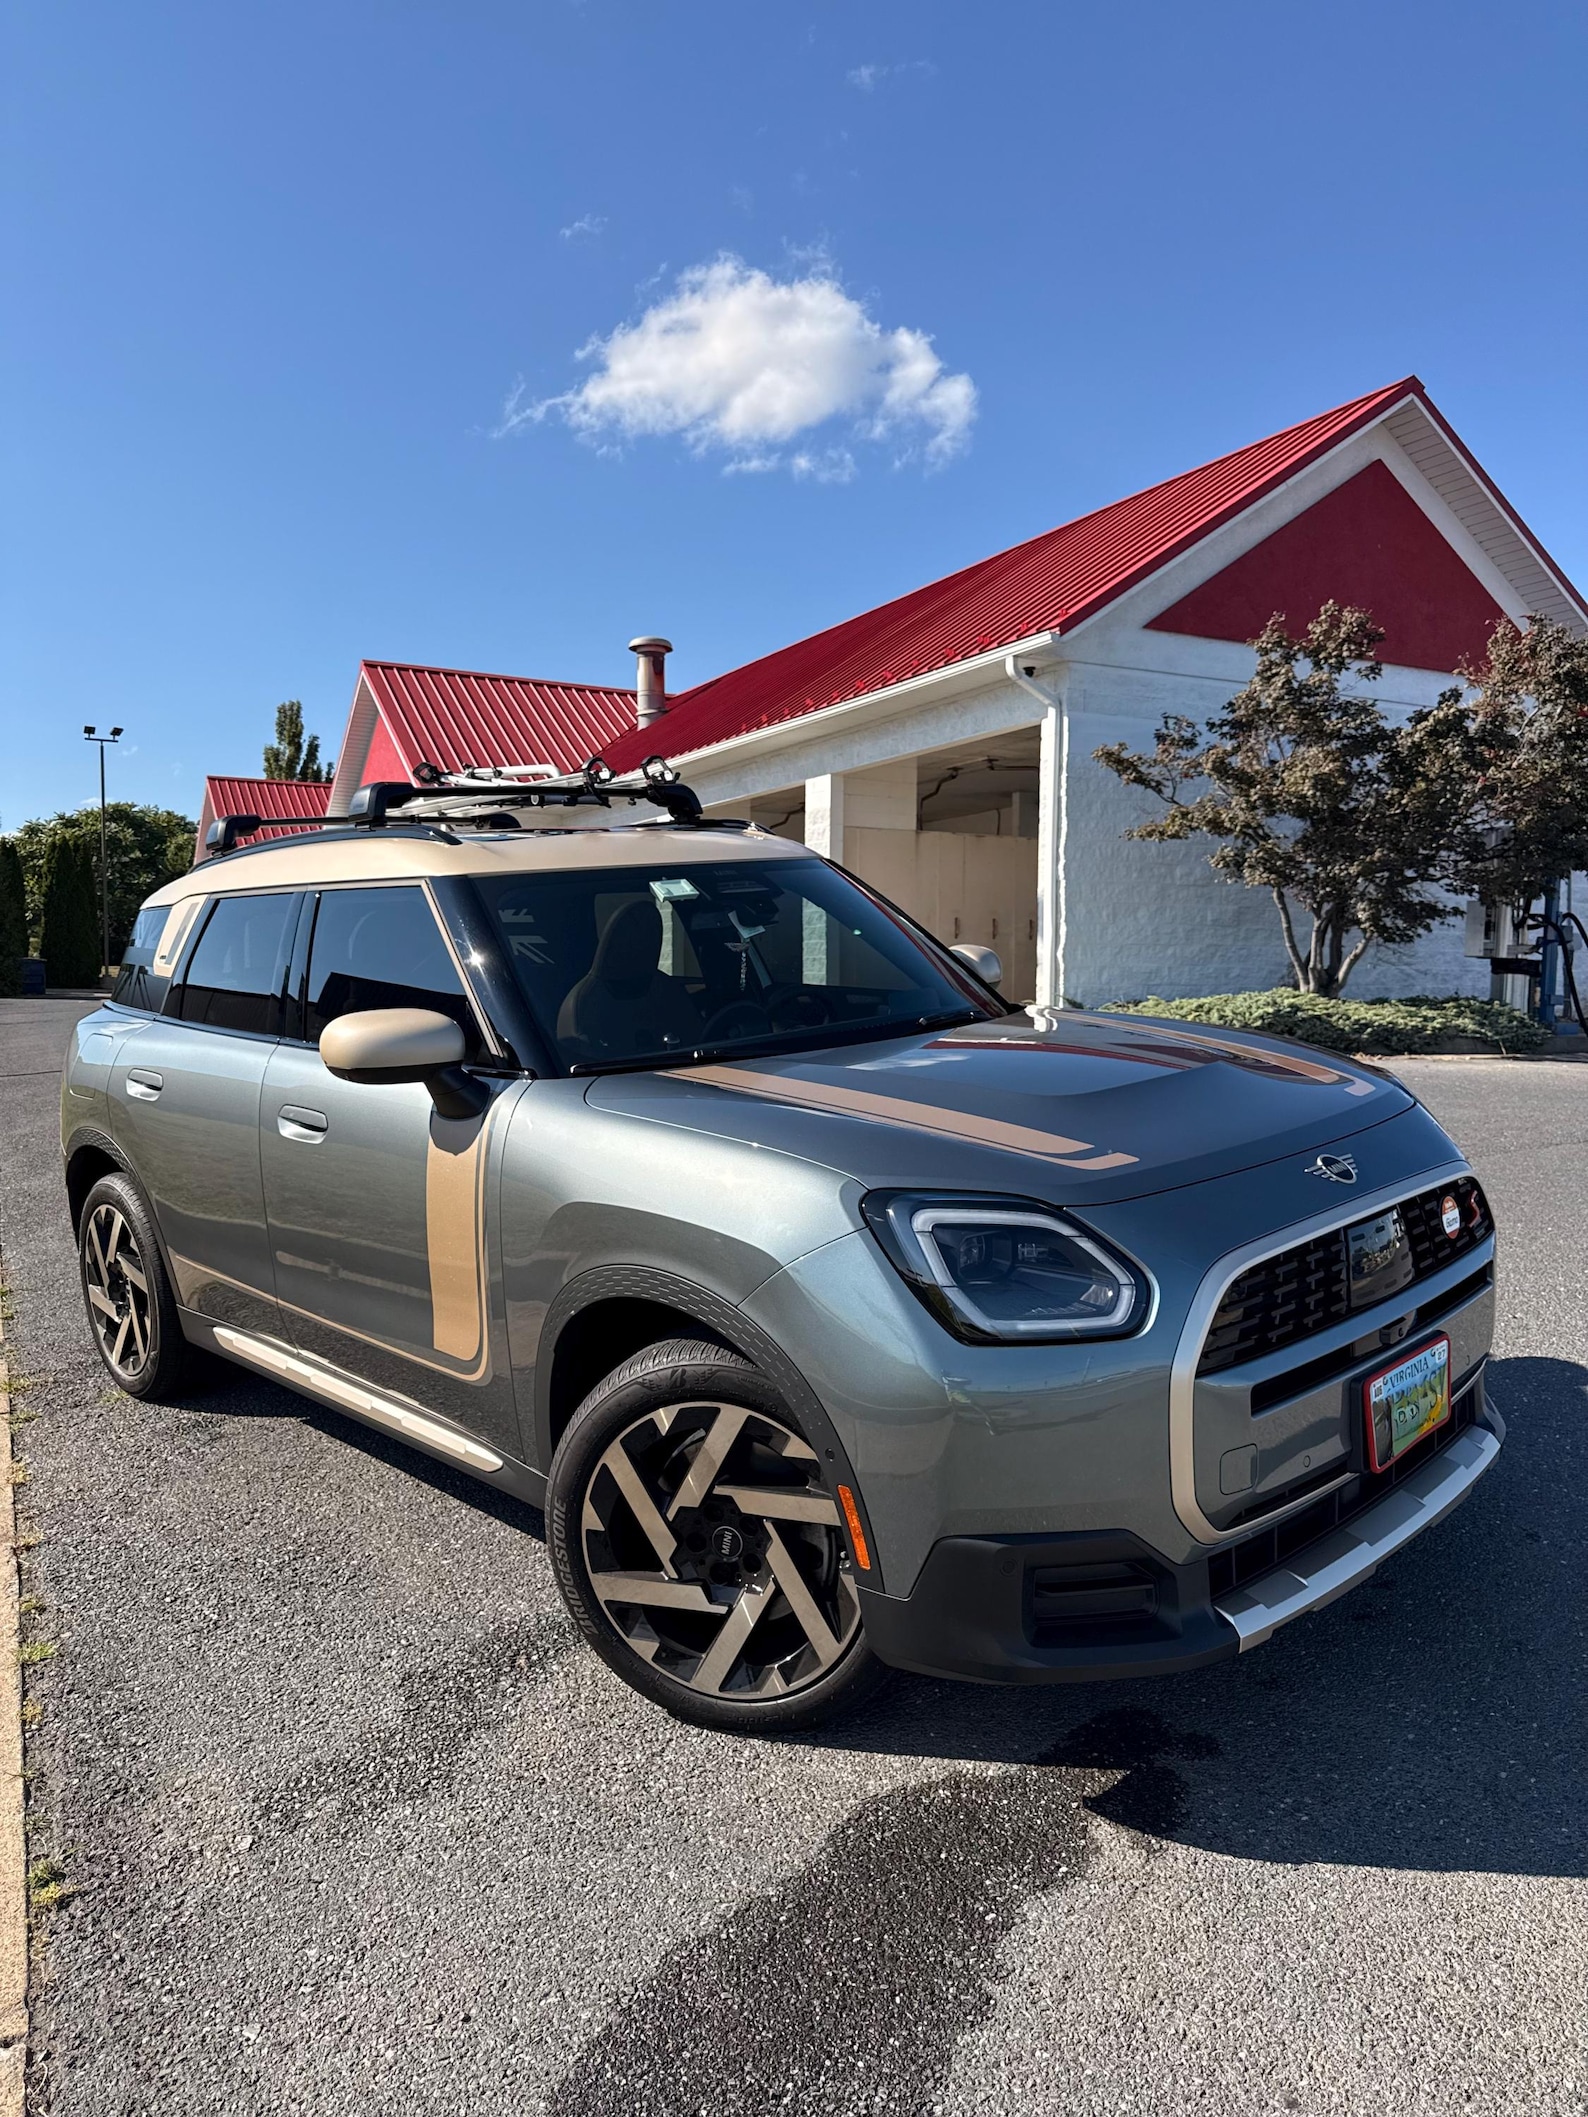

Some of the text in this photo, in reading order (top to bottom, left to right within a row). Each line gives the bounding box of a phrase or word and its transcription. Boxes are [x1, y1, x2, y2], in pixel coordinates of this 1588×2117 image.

[1437, 1349, 1446, 1360] 27
[1389, 1357, 1429, 1387] VIRGINIA
[721, 1531, 733, 1555] MINI
[552, 1498, 599, 1634] BRIDGESTONE
